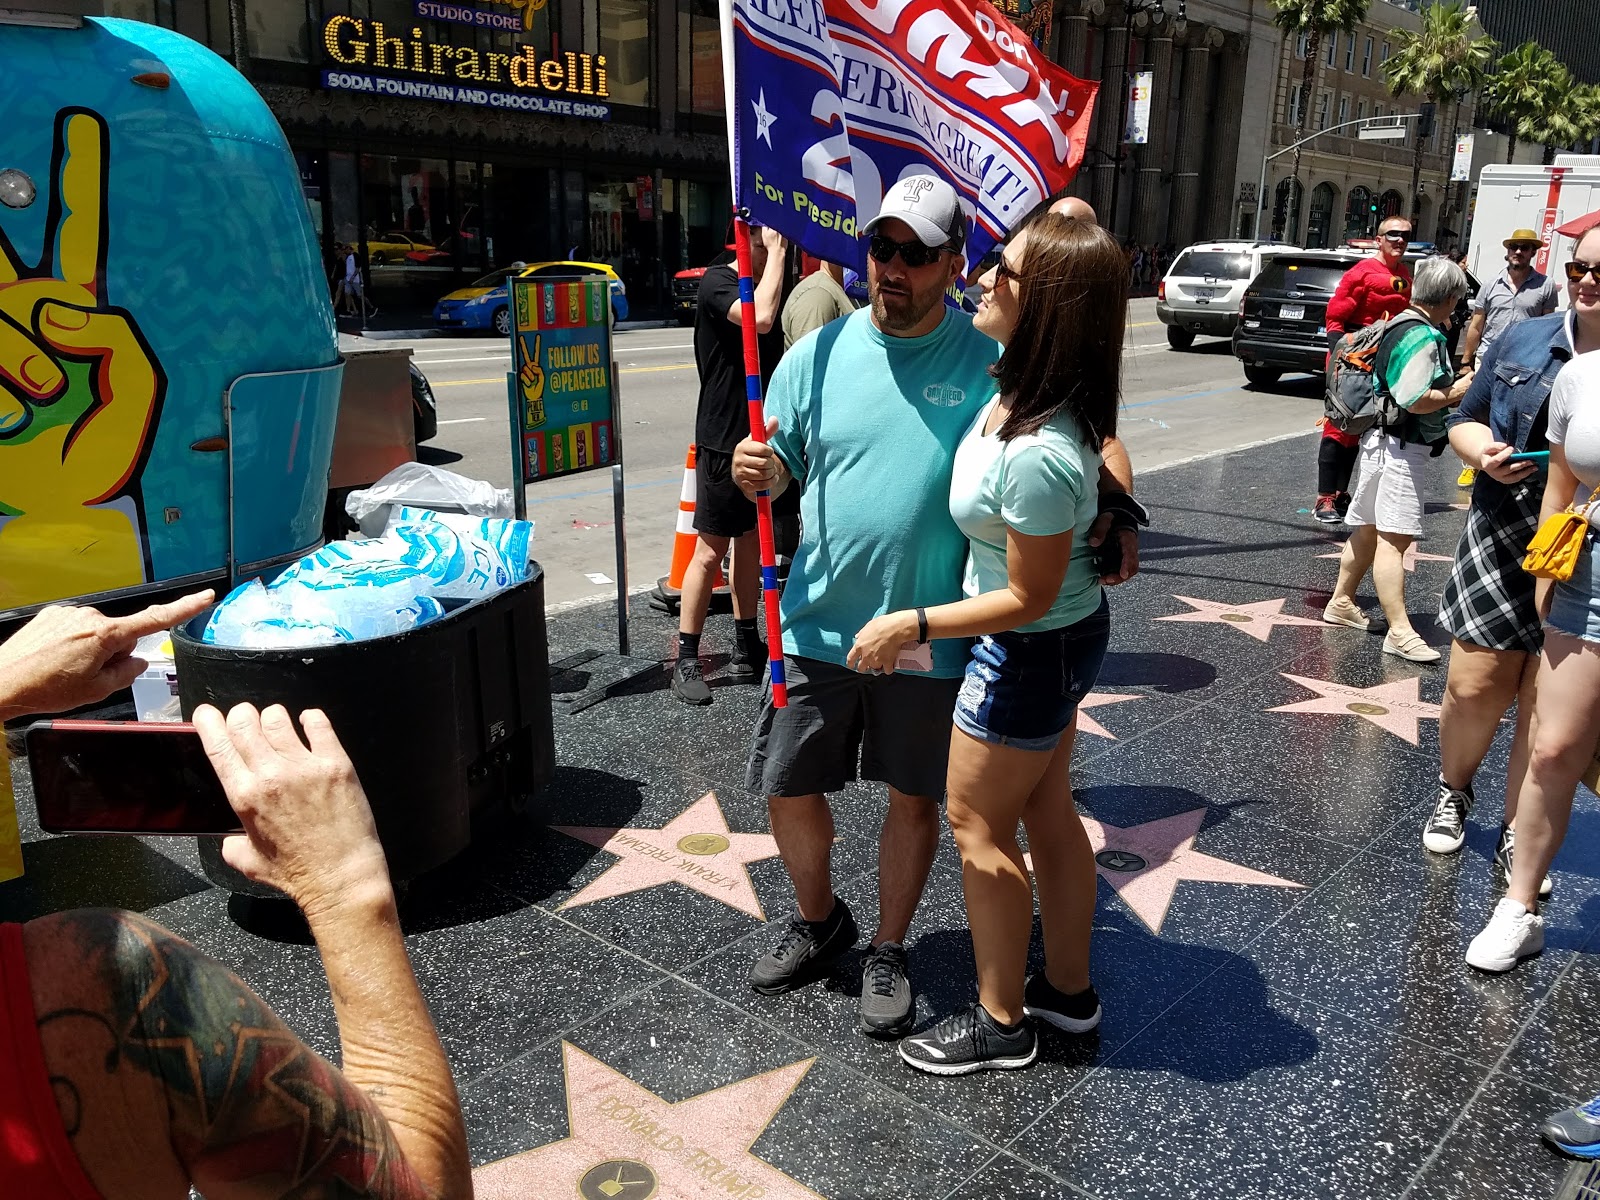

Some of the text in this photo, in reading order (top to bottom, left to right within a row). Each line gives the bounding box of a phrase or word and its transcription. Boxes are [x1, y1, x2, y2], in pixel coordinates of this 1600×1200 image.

[418, 2, 473, 22] STUDIO
[475, 12, 522, 32] STORE
[324, 15, 609, 97] Ghirardelli
[328, 73, 609, 119] SODA FOUNTAIN AND CHOCOLATE SHOP
[1131, 87, 1148, 101] E3
[834, 53, 936, 142] ERICA
[937, 122, 1029, 212] GREAT!
[1457, 144, 1470, 153] E3
[904, 178, 934, 202] T
[755, 172, 858, 242] For Presid
[1541, 223, 1554, 252] Coke
[548, 343, 599, 370] FOLLOW US
[550, 367, 606, 393] @PEACETEA
[942, 388, 963, 402] DIEGO
[467, 542, 491, 590] ICE
[1325, 686, 1441, 714] GEORGE LOPEZ
[673, 859, 728, 884] FRANK
[596, 1096, 766, 1200] DONALD TRUMP
